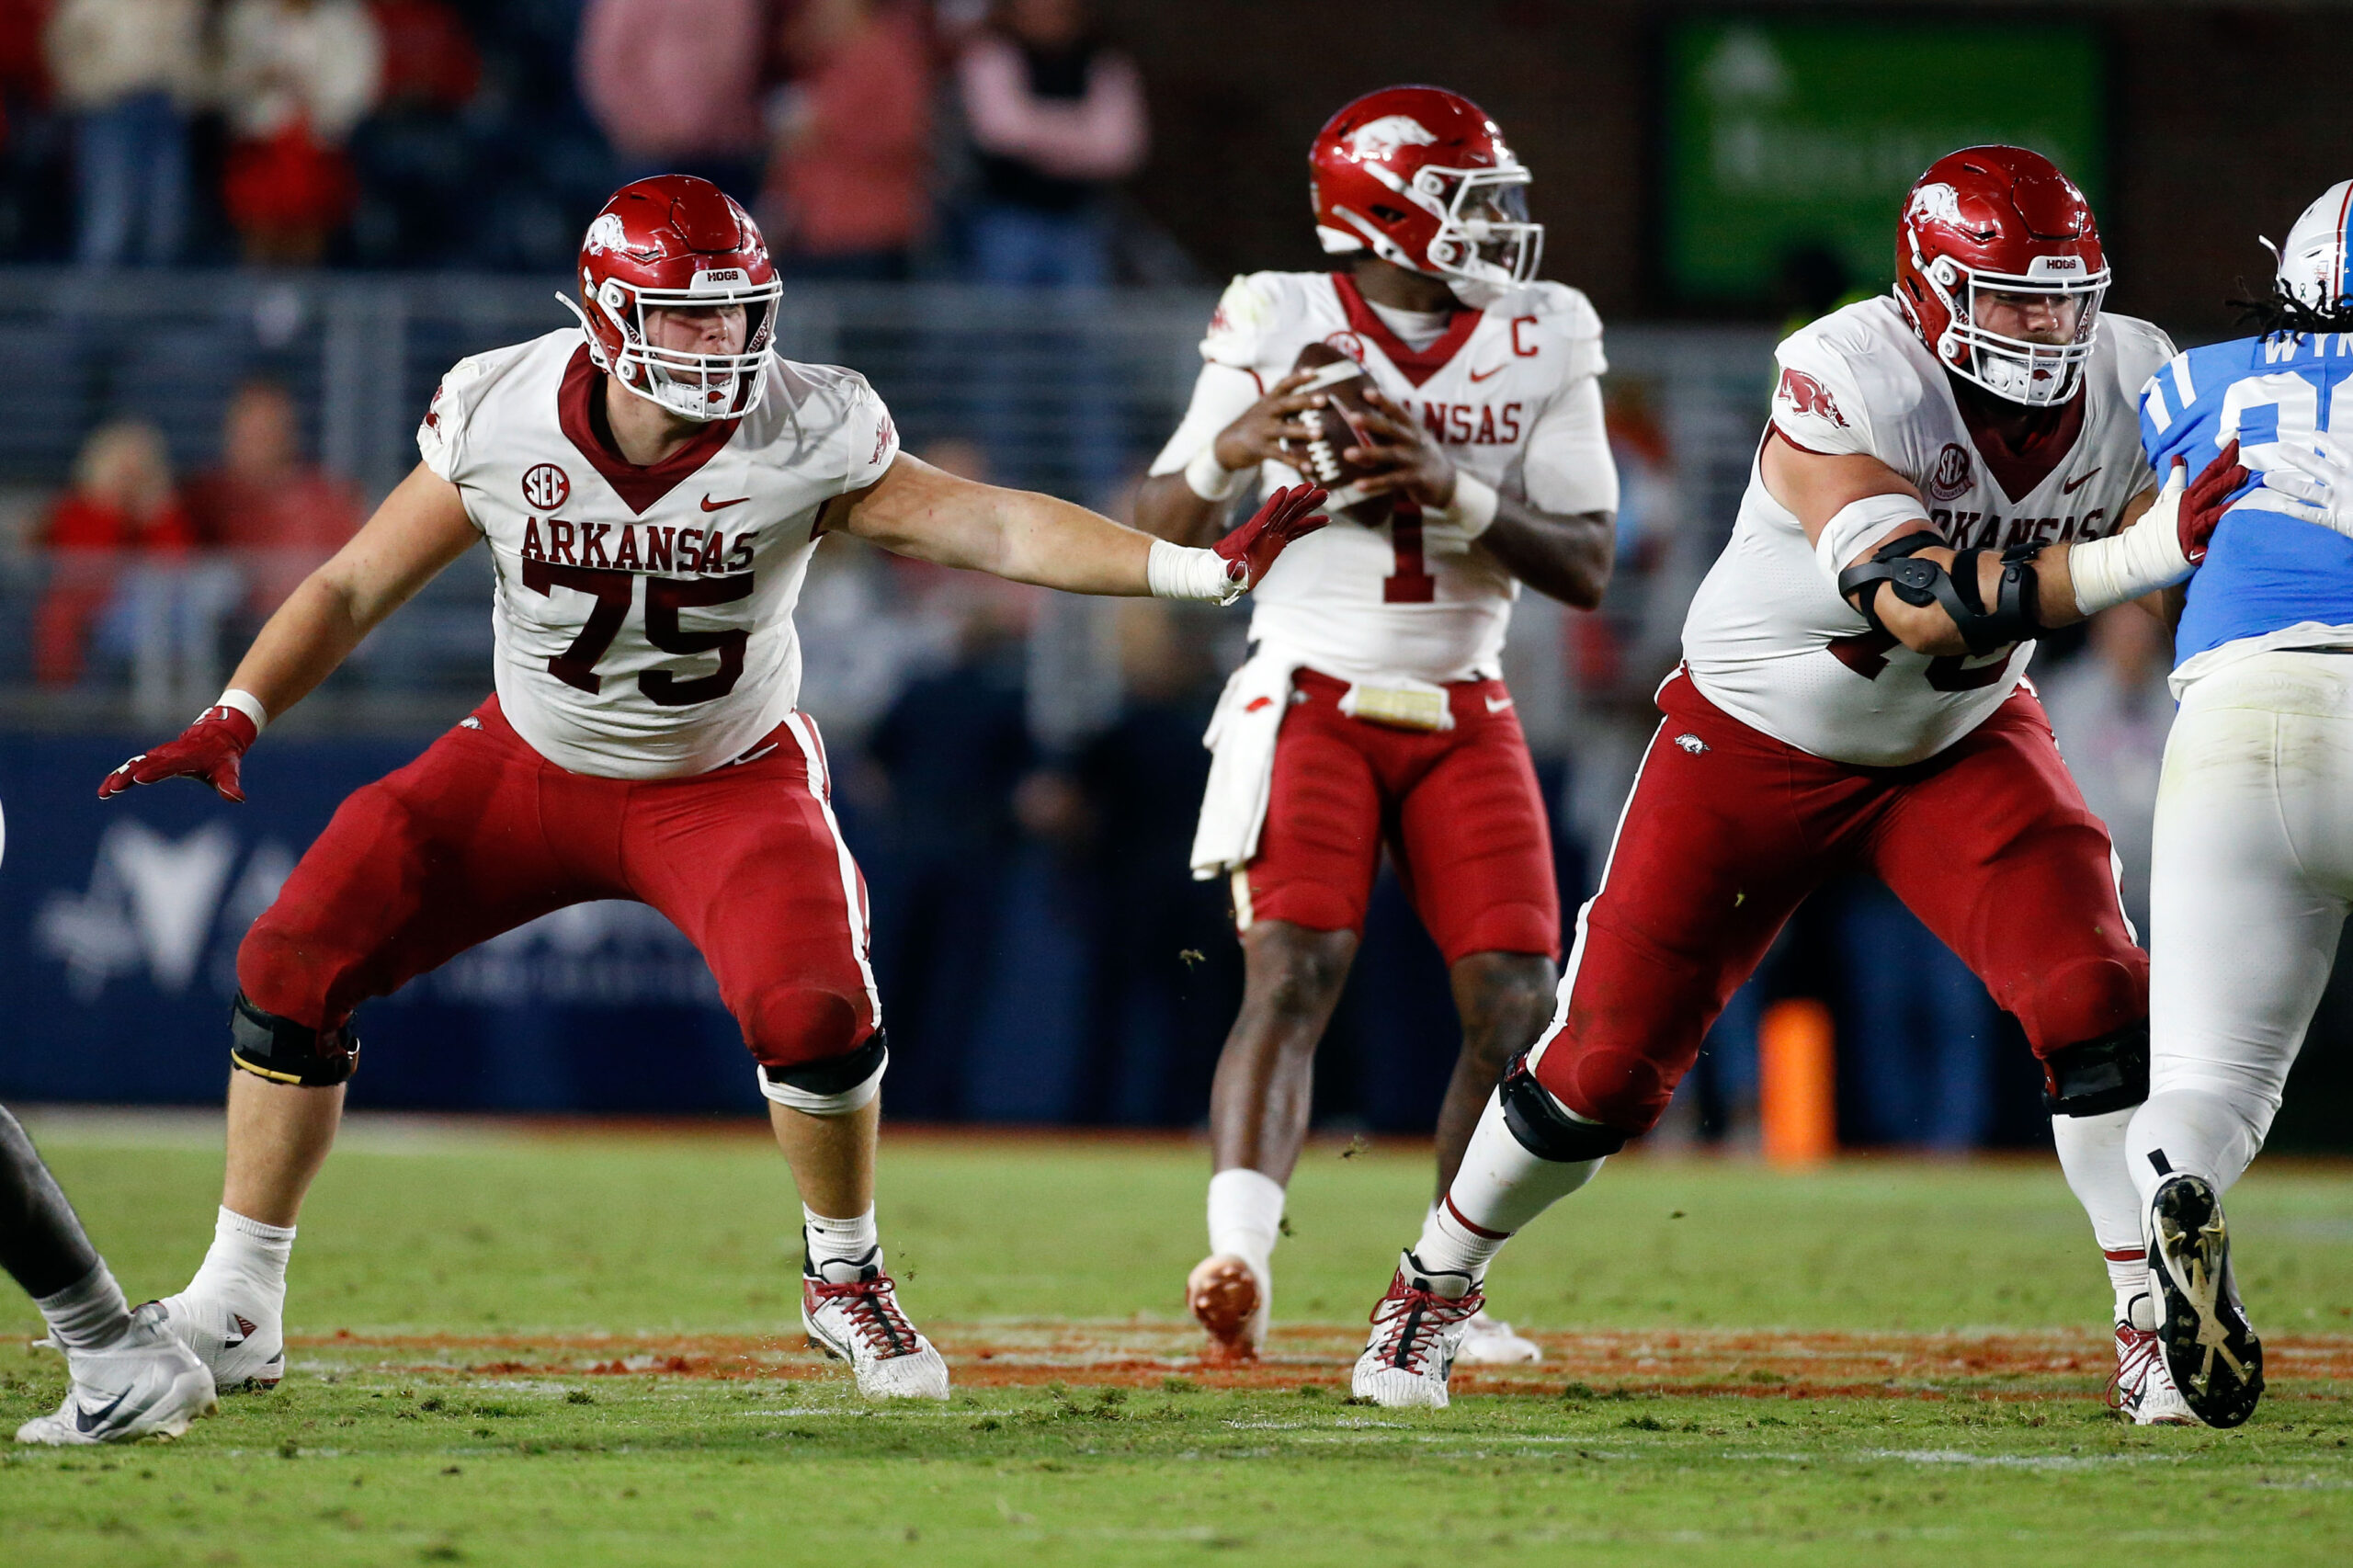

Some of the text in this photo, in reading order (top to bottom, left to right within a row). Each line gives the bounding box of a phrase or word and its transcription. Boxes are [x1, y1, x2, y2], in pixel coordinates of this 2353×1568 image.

[707, 270, 739, 282] HOGS
[2046, 259, 2076, 269] HOGS
[1511, 315, 1539, 358] C
[525, 465, 567, 507] SEC
[1938, 447, 1966, 486] SEC
[521, 516, 759, 574] ARKANSAS
[1383, 492, 1435, 603] 1
[522, 557, 756, 706] 75
